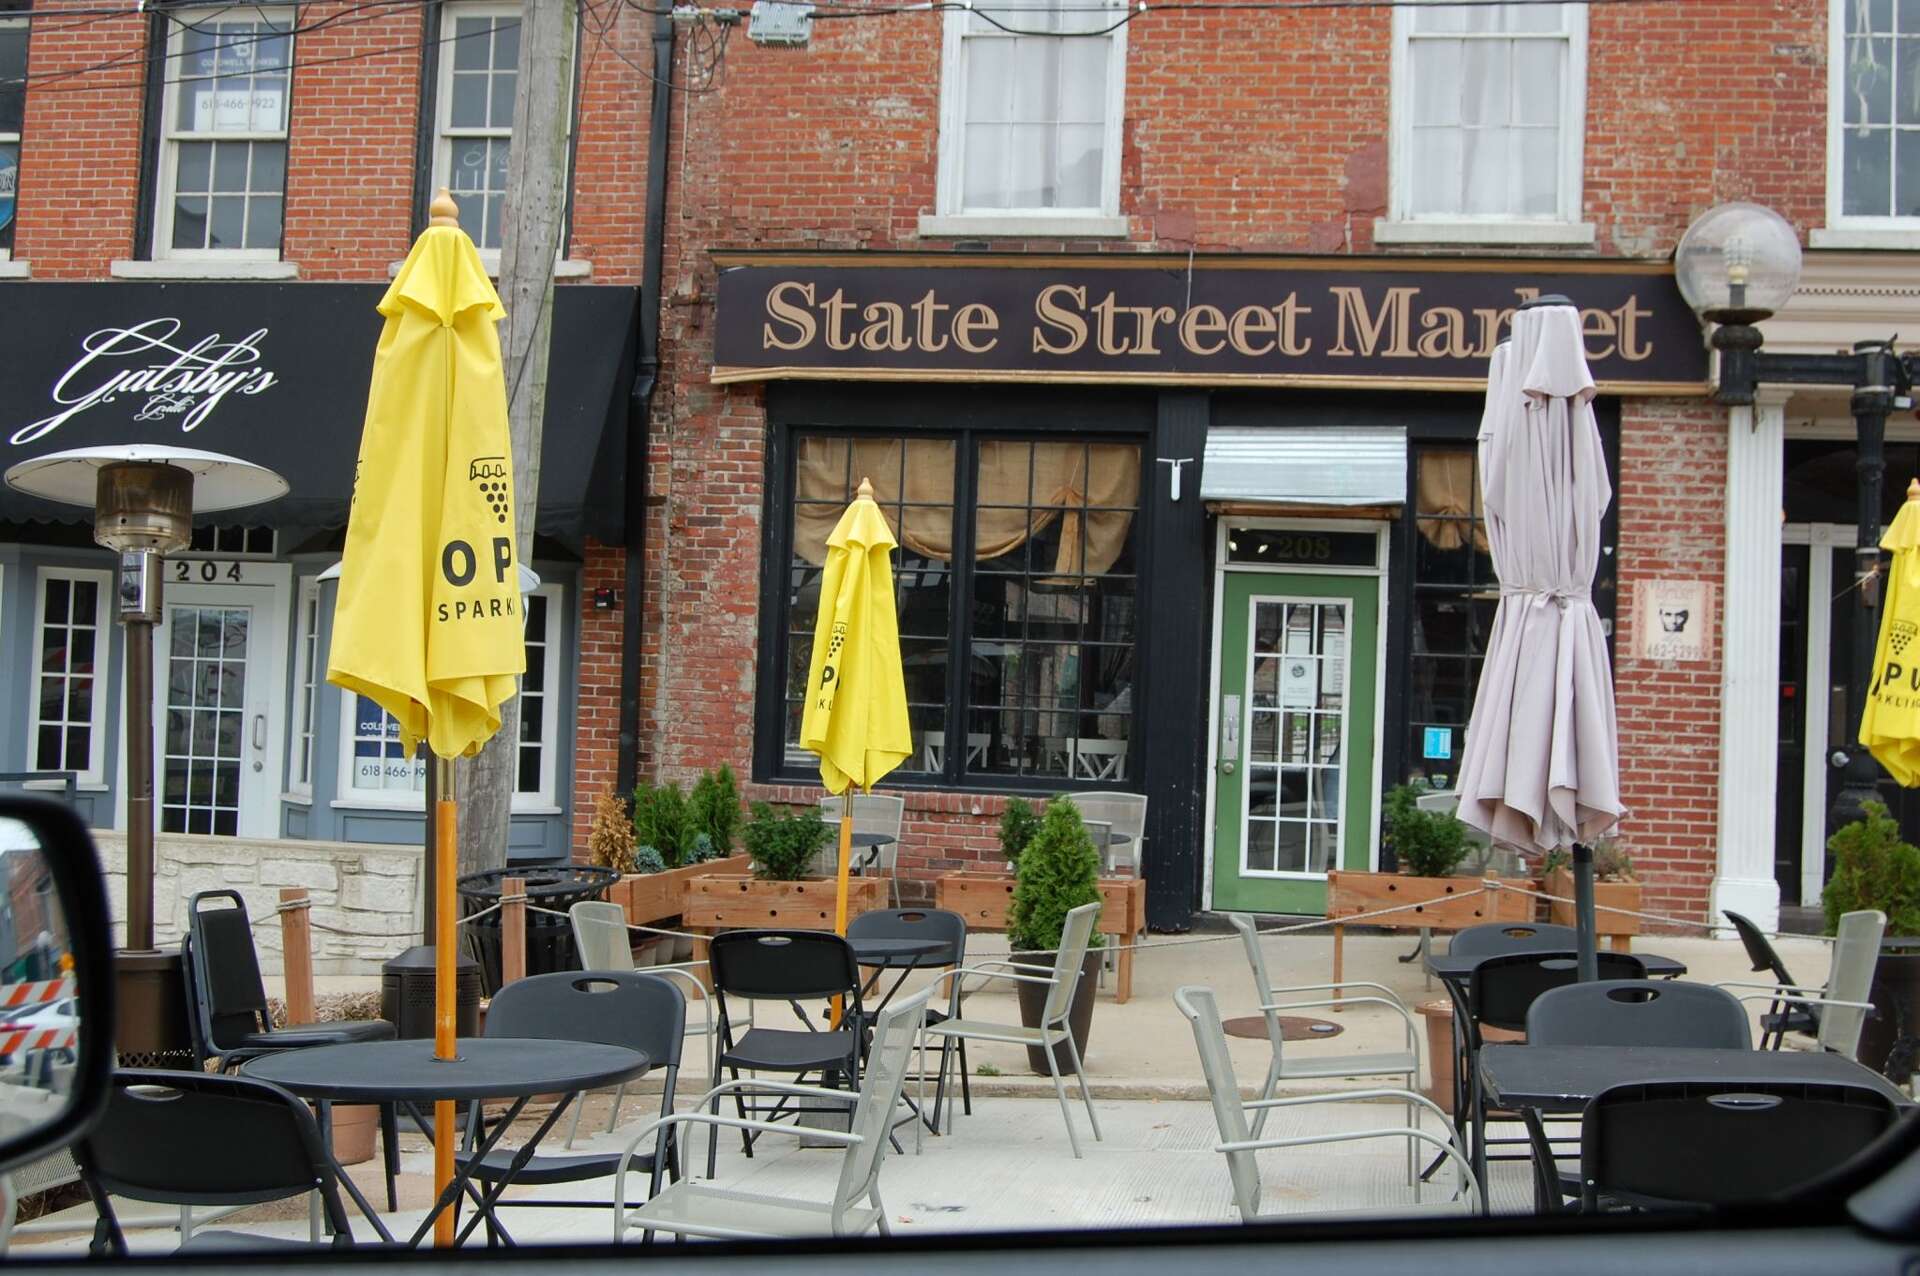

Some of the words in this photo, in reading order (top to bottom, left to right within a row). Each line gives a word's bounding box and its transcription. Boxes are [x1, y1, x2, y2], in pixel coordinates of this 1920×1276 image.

[763, 281, 1000, 354] State
[1032, 284, 1312, 357] Street
[1327, 286, 1653, 362] Maret
[9, 317, 279, 445] Gatsby's
[1277, 536, 1331, 559] 208
[175, 560, 243, 582] 204
[361, 764, 426, 778] 618466-9
